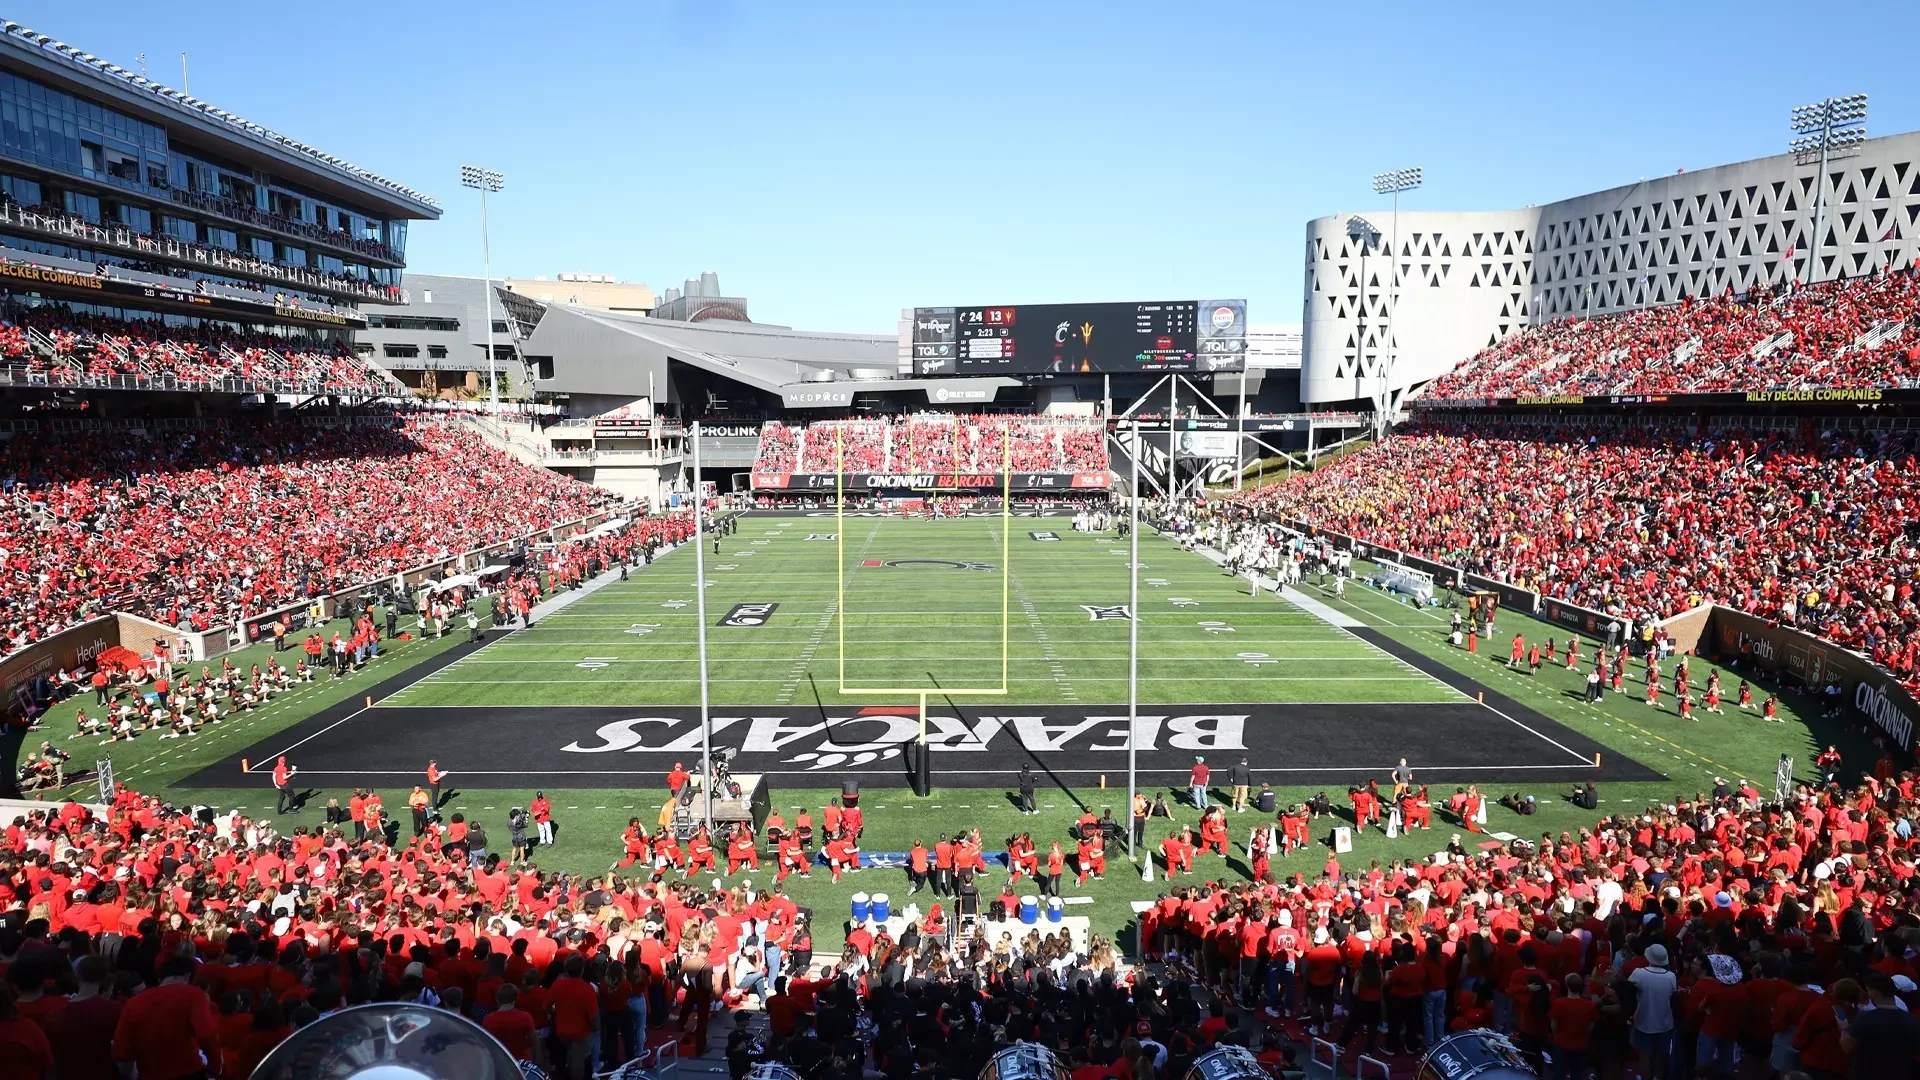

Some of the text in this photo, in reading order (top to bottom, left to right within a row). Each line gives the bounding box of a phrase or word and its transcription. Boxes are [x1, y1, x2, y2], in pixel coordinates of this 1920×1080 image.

[41, 270, 102, 289] COMPANIES
[275, 307, 346, 325] RILEY DECKER COMPANIES
[968, 311, 983, 322] 24
[989, 310, 1002, 322] 13
[977, 328, 993, 337] 2:23
[917, 346, 939, 356] TQL
[1205, 342, 1228, 352] TQL
[789, 391, 846, 402] MEDPACE
[1552, 396, 1584, 404] COMPANIES
[1746, 389, 1882, 402] RILEY DECKER COMPANIES
[699, 426, 758, 437] PROLINK
[866, 475, 995, 487] CINCINNATI BEARCATS
[1560, 611, 1579, 623] TOYOTA
[76, 637, 108, 664] Health
[1789, 654, 1805, 670] 1924
[1855, 681, 1913, 751] CINCINNATI
[559, 715, 1252, 754] BEARCATS
[1210, 1059, 1228, 1077] CINCY
[1439, 1053, 1462, 1077] CINCY
